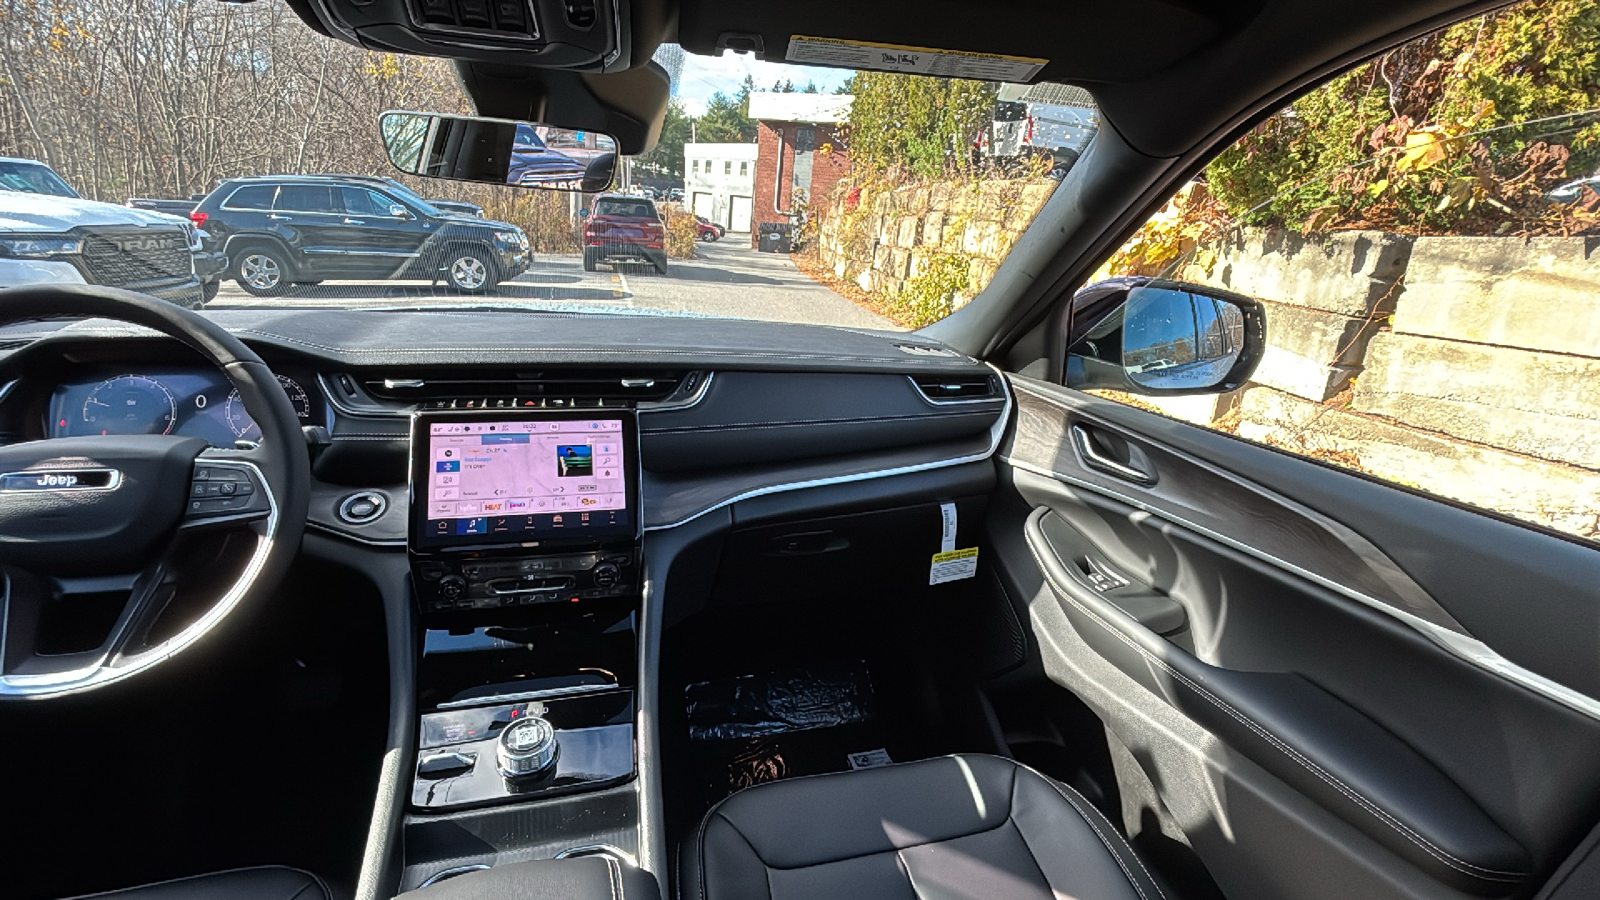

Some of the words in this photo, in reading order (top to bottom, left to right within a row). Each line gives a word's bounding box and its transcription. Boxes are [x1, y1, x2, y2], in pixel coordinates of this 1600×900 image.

[124, 239, 174, 251] RAM
[195, 394, 207, 408] 0
[37, 474, 78, 487] Jeep
[484, 503, 502, 511] HEAT
[511, 710, 519, 718] P
